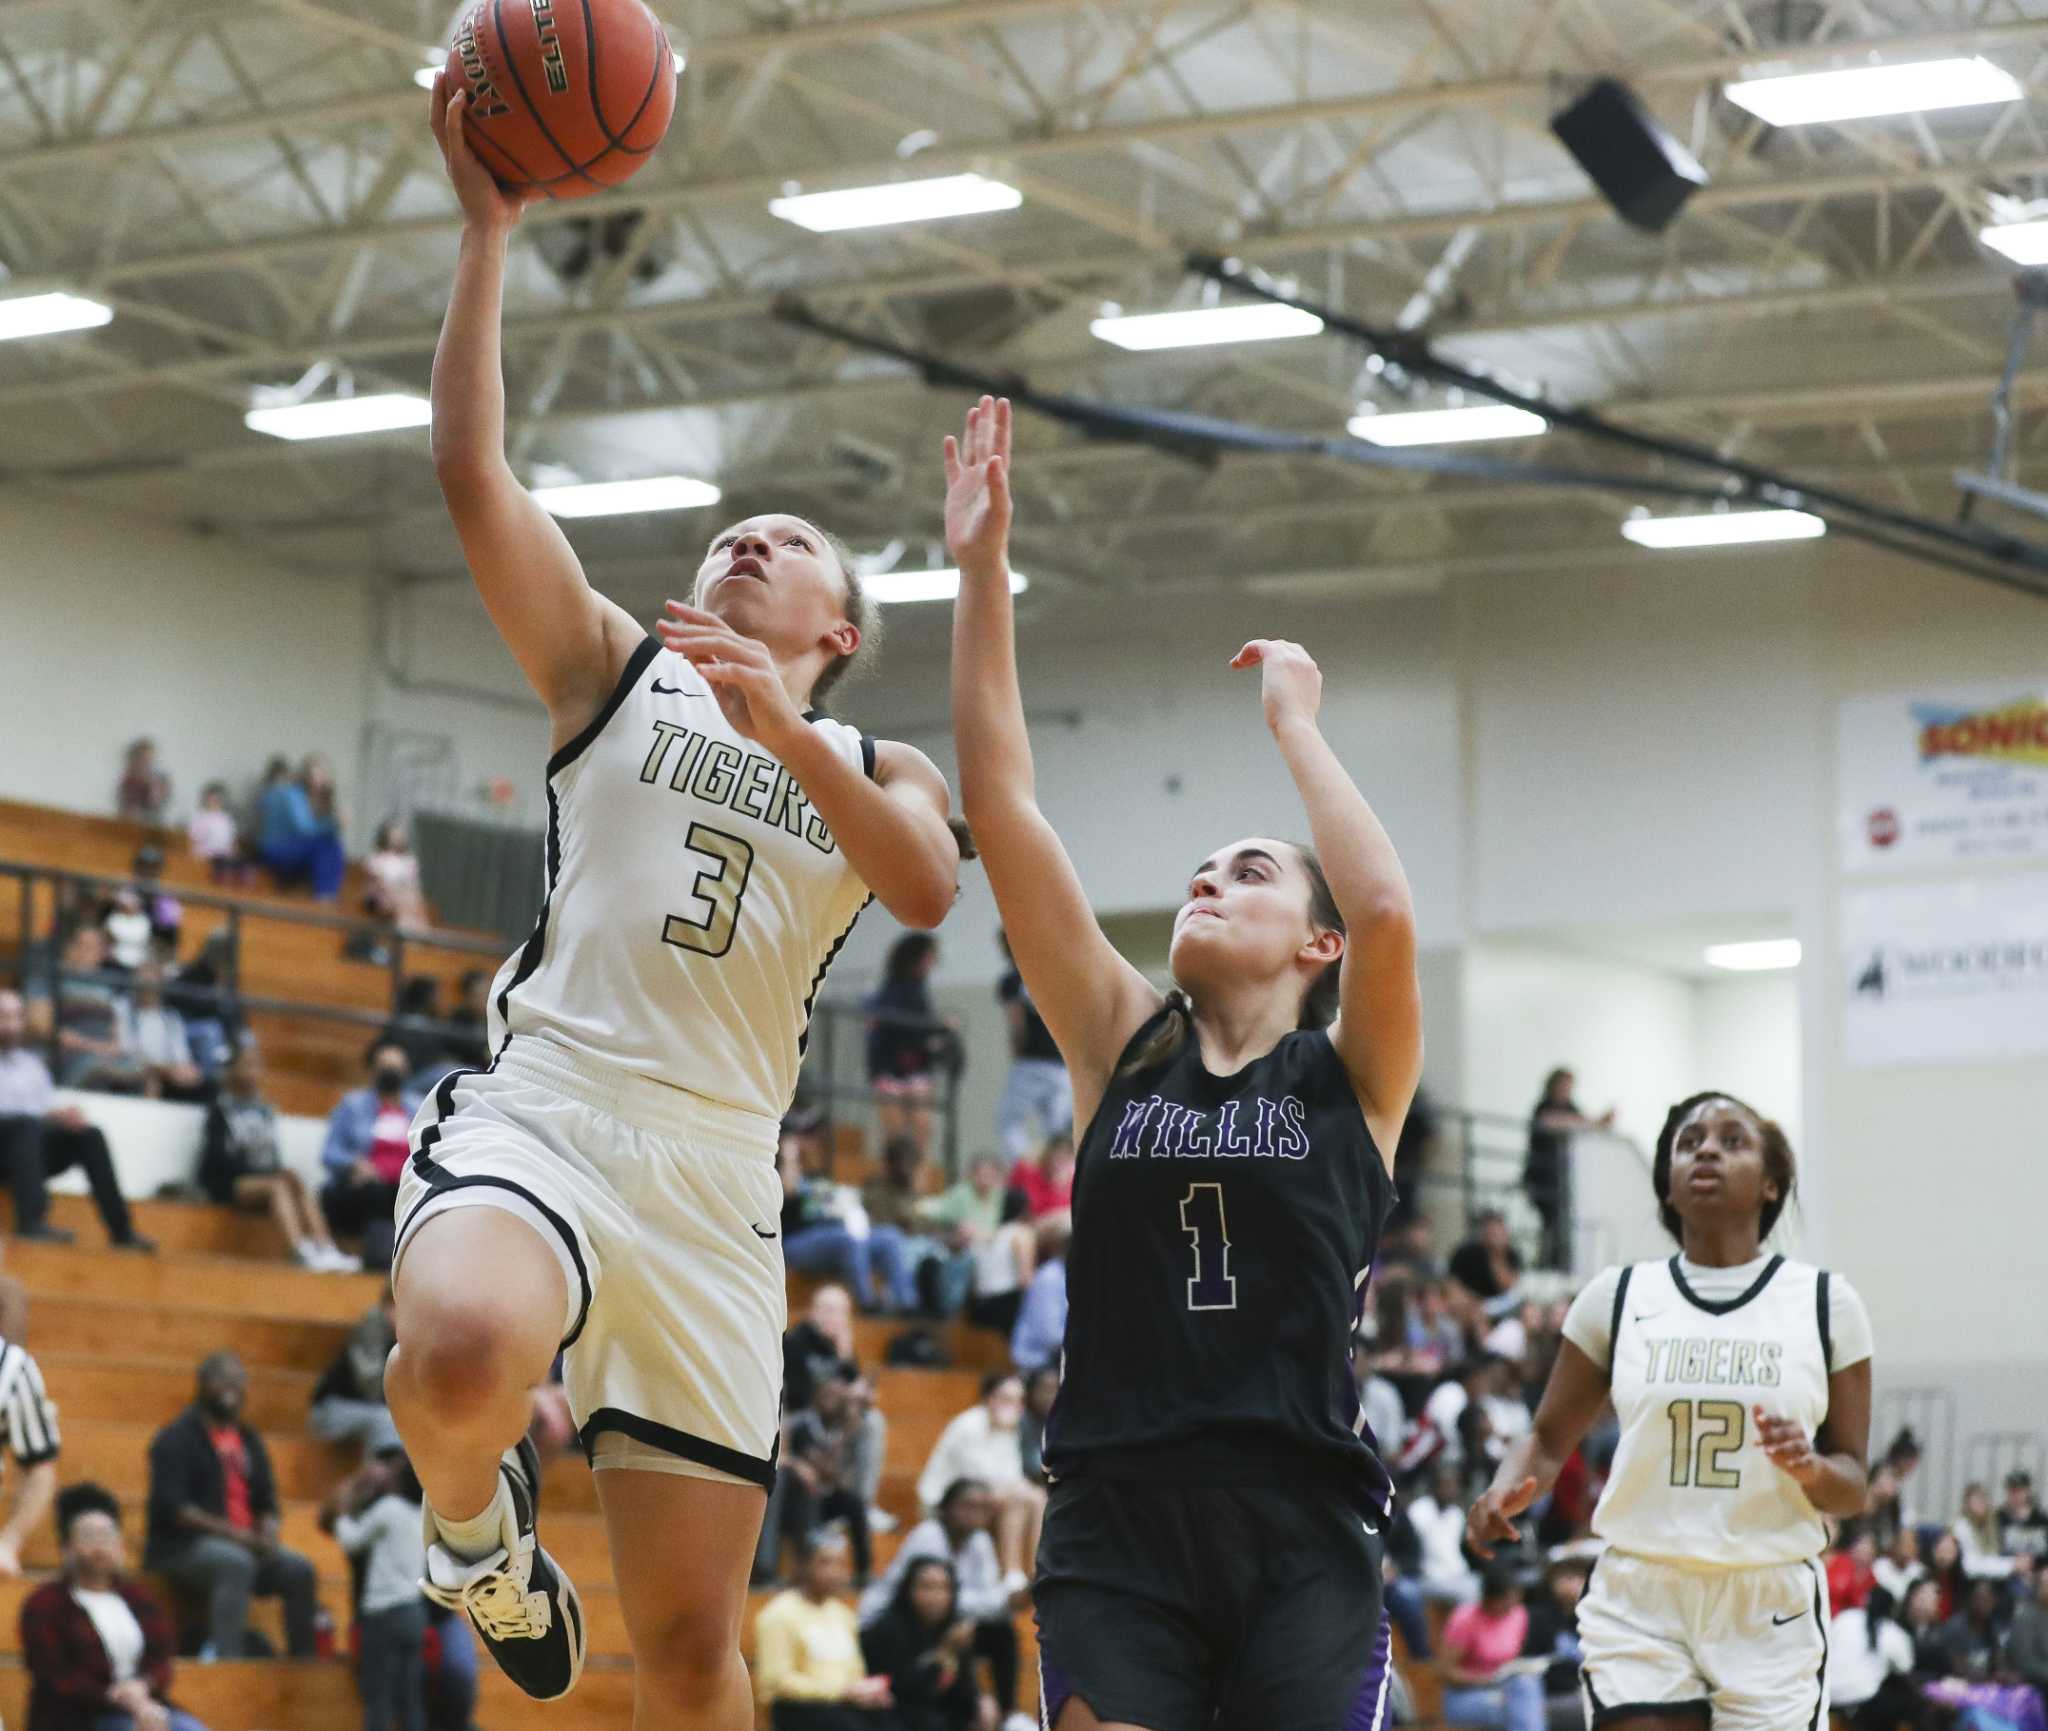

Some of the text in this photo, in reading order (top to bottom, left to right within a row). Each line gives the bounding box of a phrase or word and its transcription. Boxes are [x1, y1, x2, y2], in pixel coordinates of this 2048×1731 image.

[661, 821, 754, 958] 3
[1110, 1095, 1309, 1160] WILLIS
[1179, 1183, 1238, 1311] 1
[1646, 1338, 1783, 1387] TIGERS
[1667, 1399, 1745, 1488] 12
